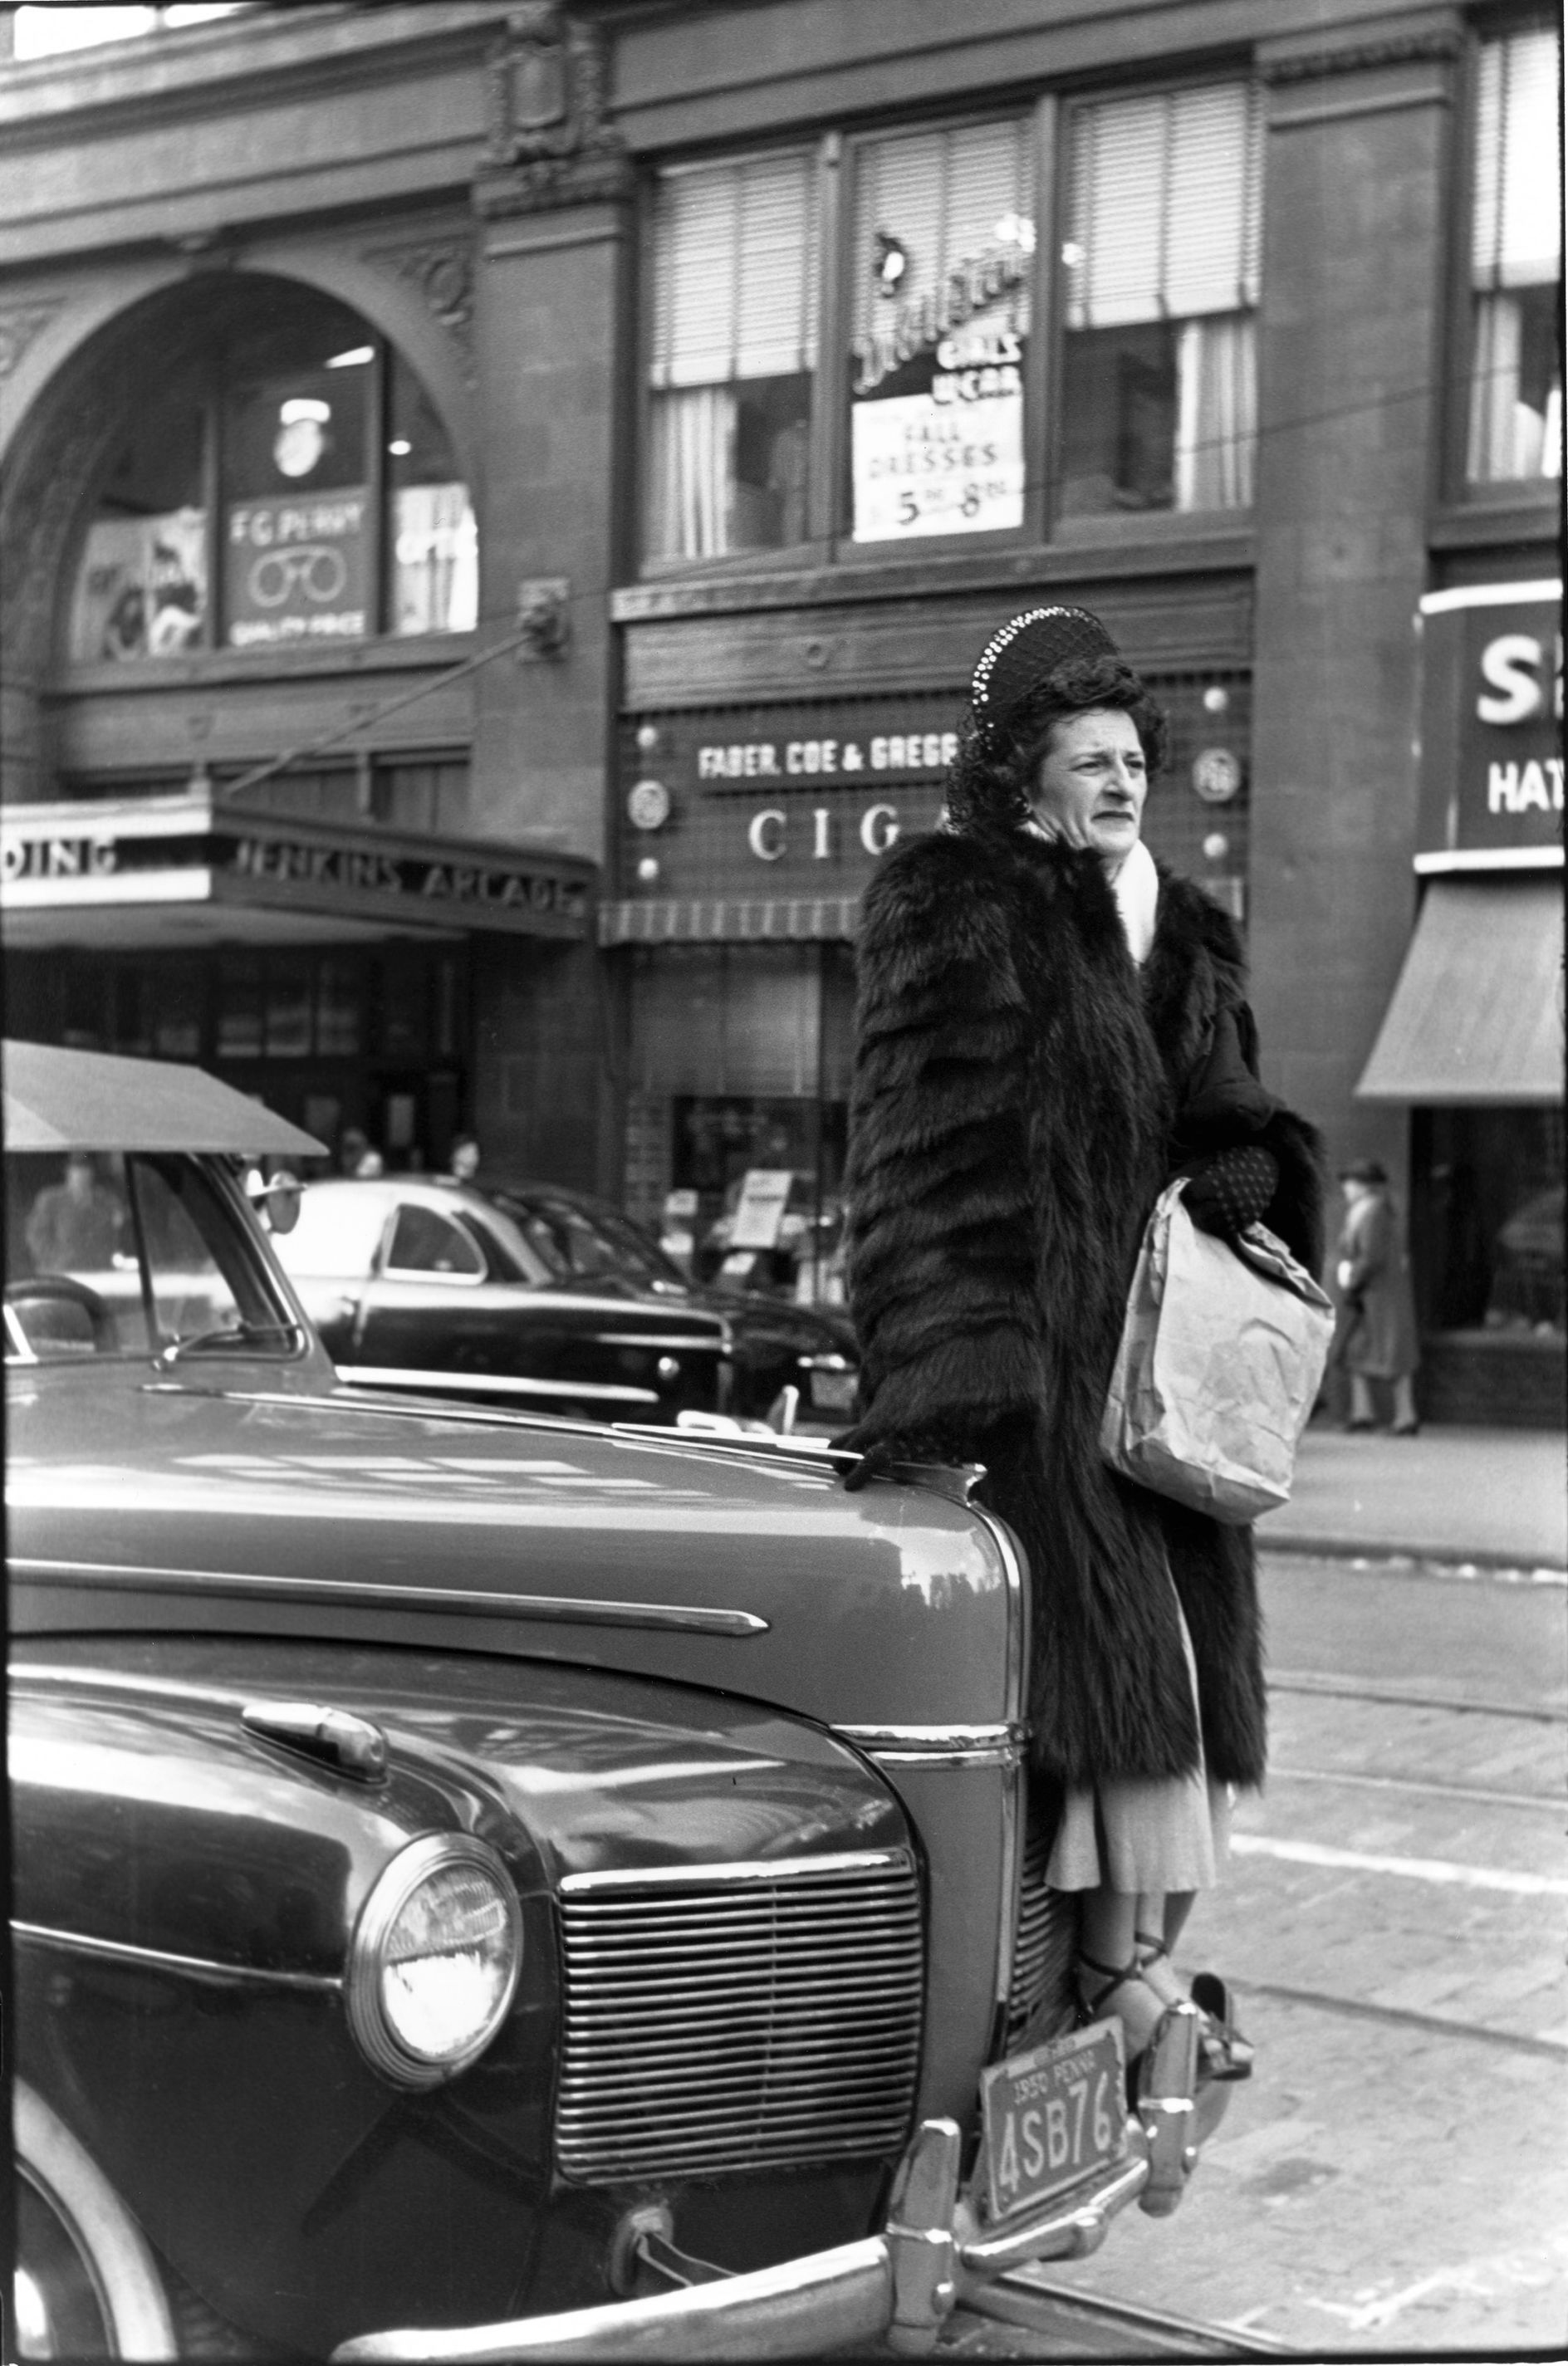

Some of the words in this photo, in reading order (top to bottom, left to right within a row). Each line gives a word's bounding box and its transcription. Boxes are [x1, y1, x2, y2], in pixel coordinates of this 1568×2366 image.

[1477, 634, 1564, 724] S
[785, 739, 838, 774] COE
[841, 743, 863, 772] &
[749, 803, 951, 861] CIG
[236, 838, 404, 894] JENKINS
[422, 865, 580, 914] ARCADE
